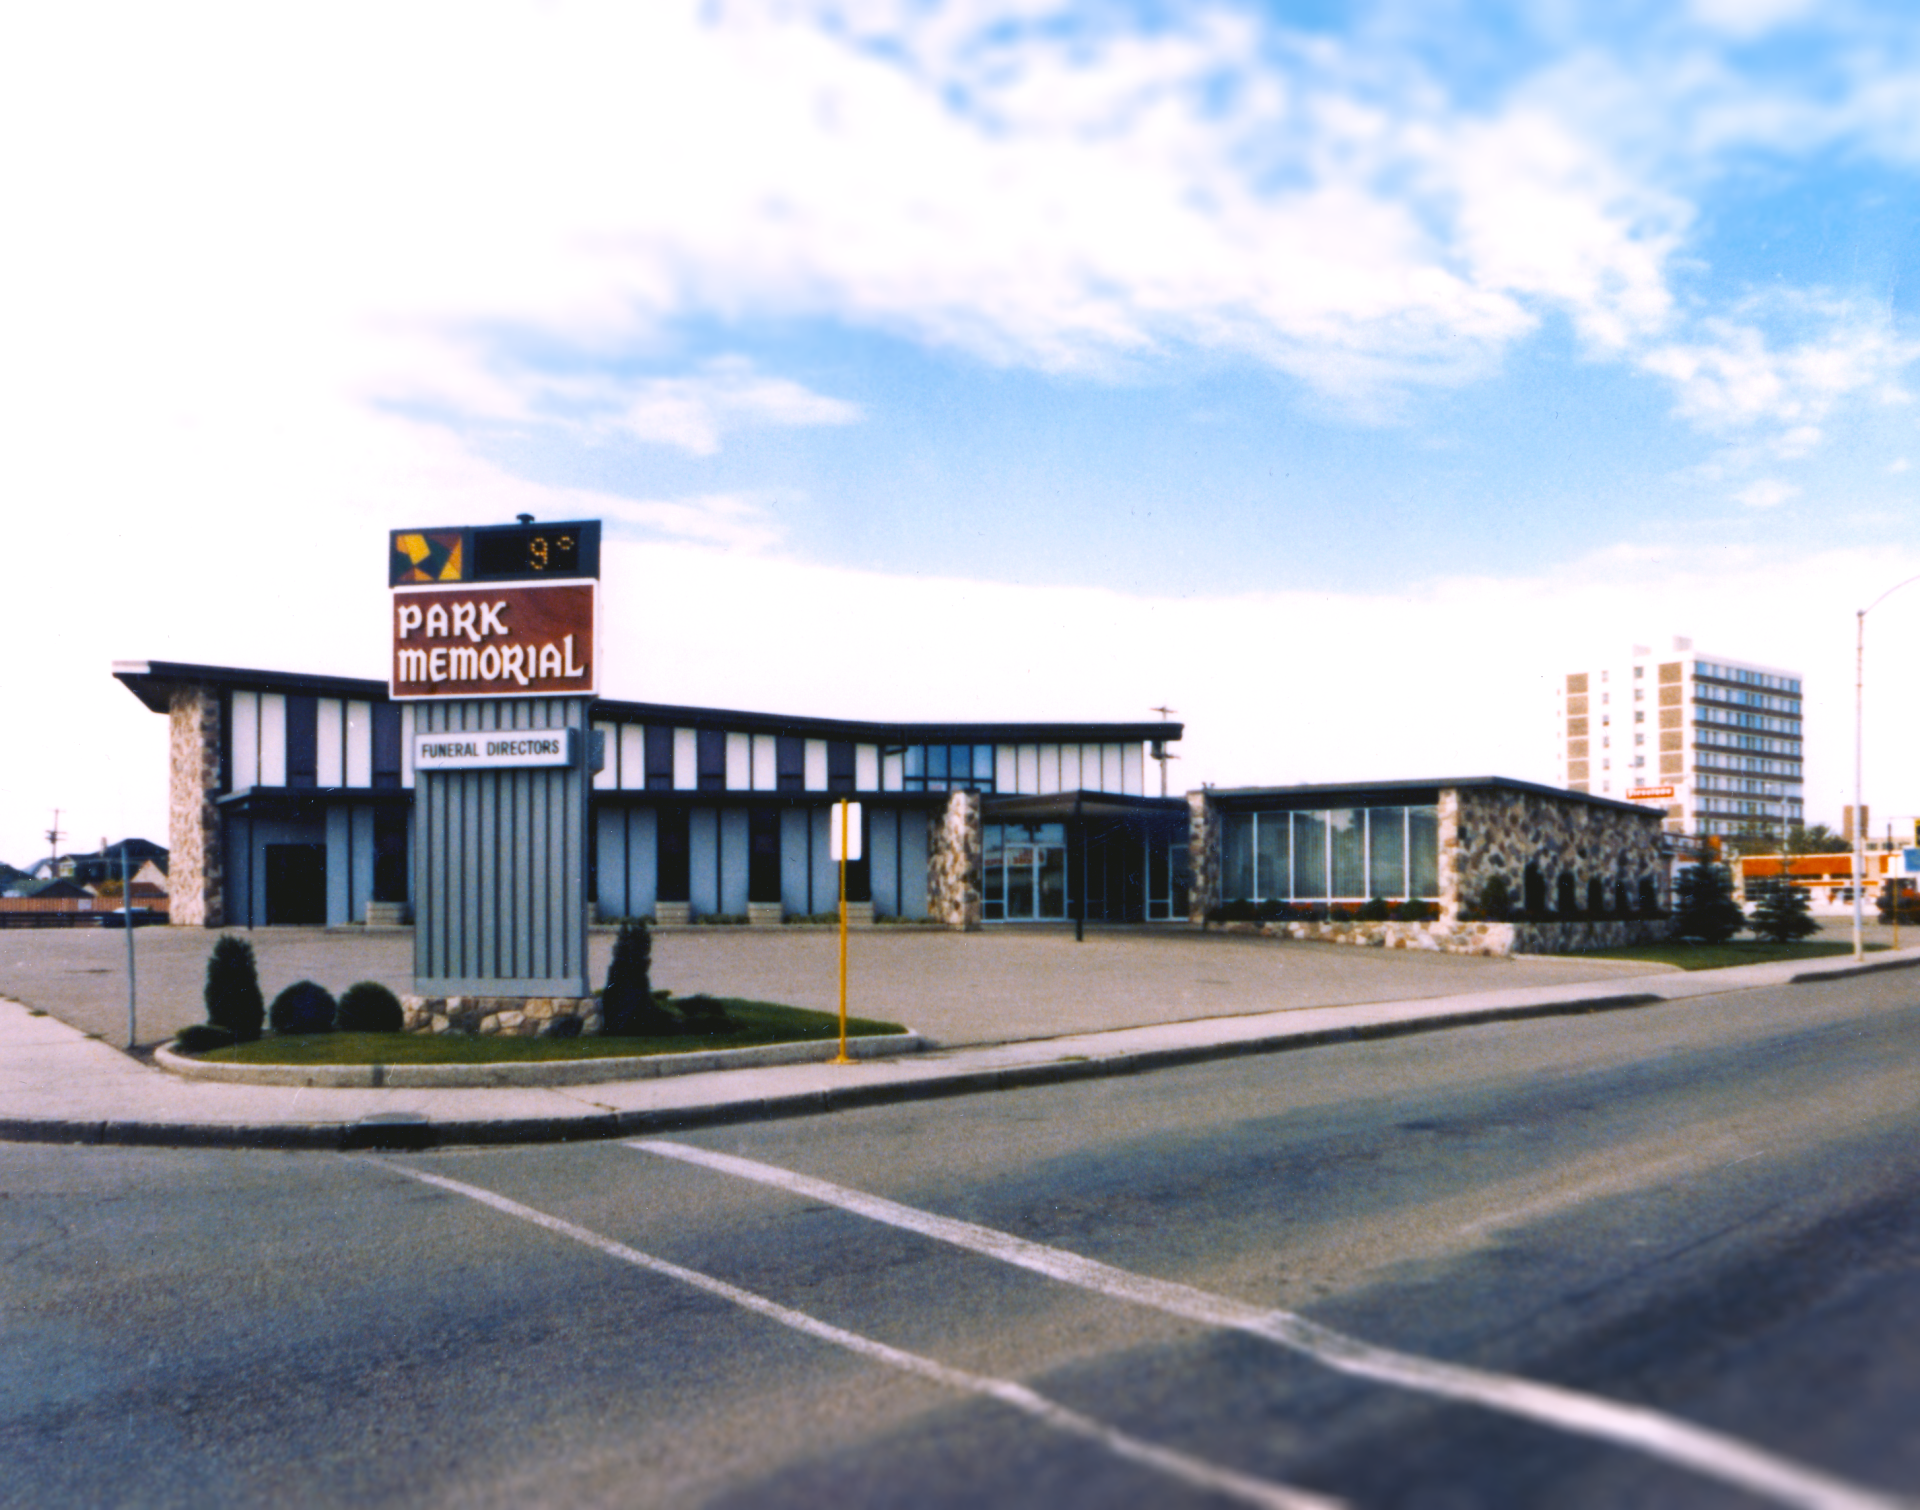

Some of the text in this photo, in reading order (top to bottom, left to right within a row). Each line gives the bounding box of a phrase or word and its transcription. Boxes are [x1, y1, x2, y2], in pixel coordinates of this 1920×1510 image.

[398, 601, 508, 642] PARK
[398, 634, 584, 685] MEMORIAL
[421, 740, 559, 758] FUNERAL DIRECTORS
